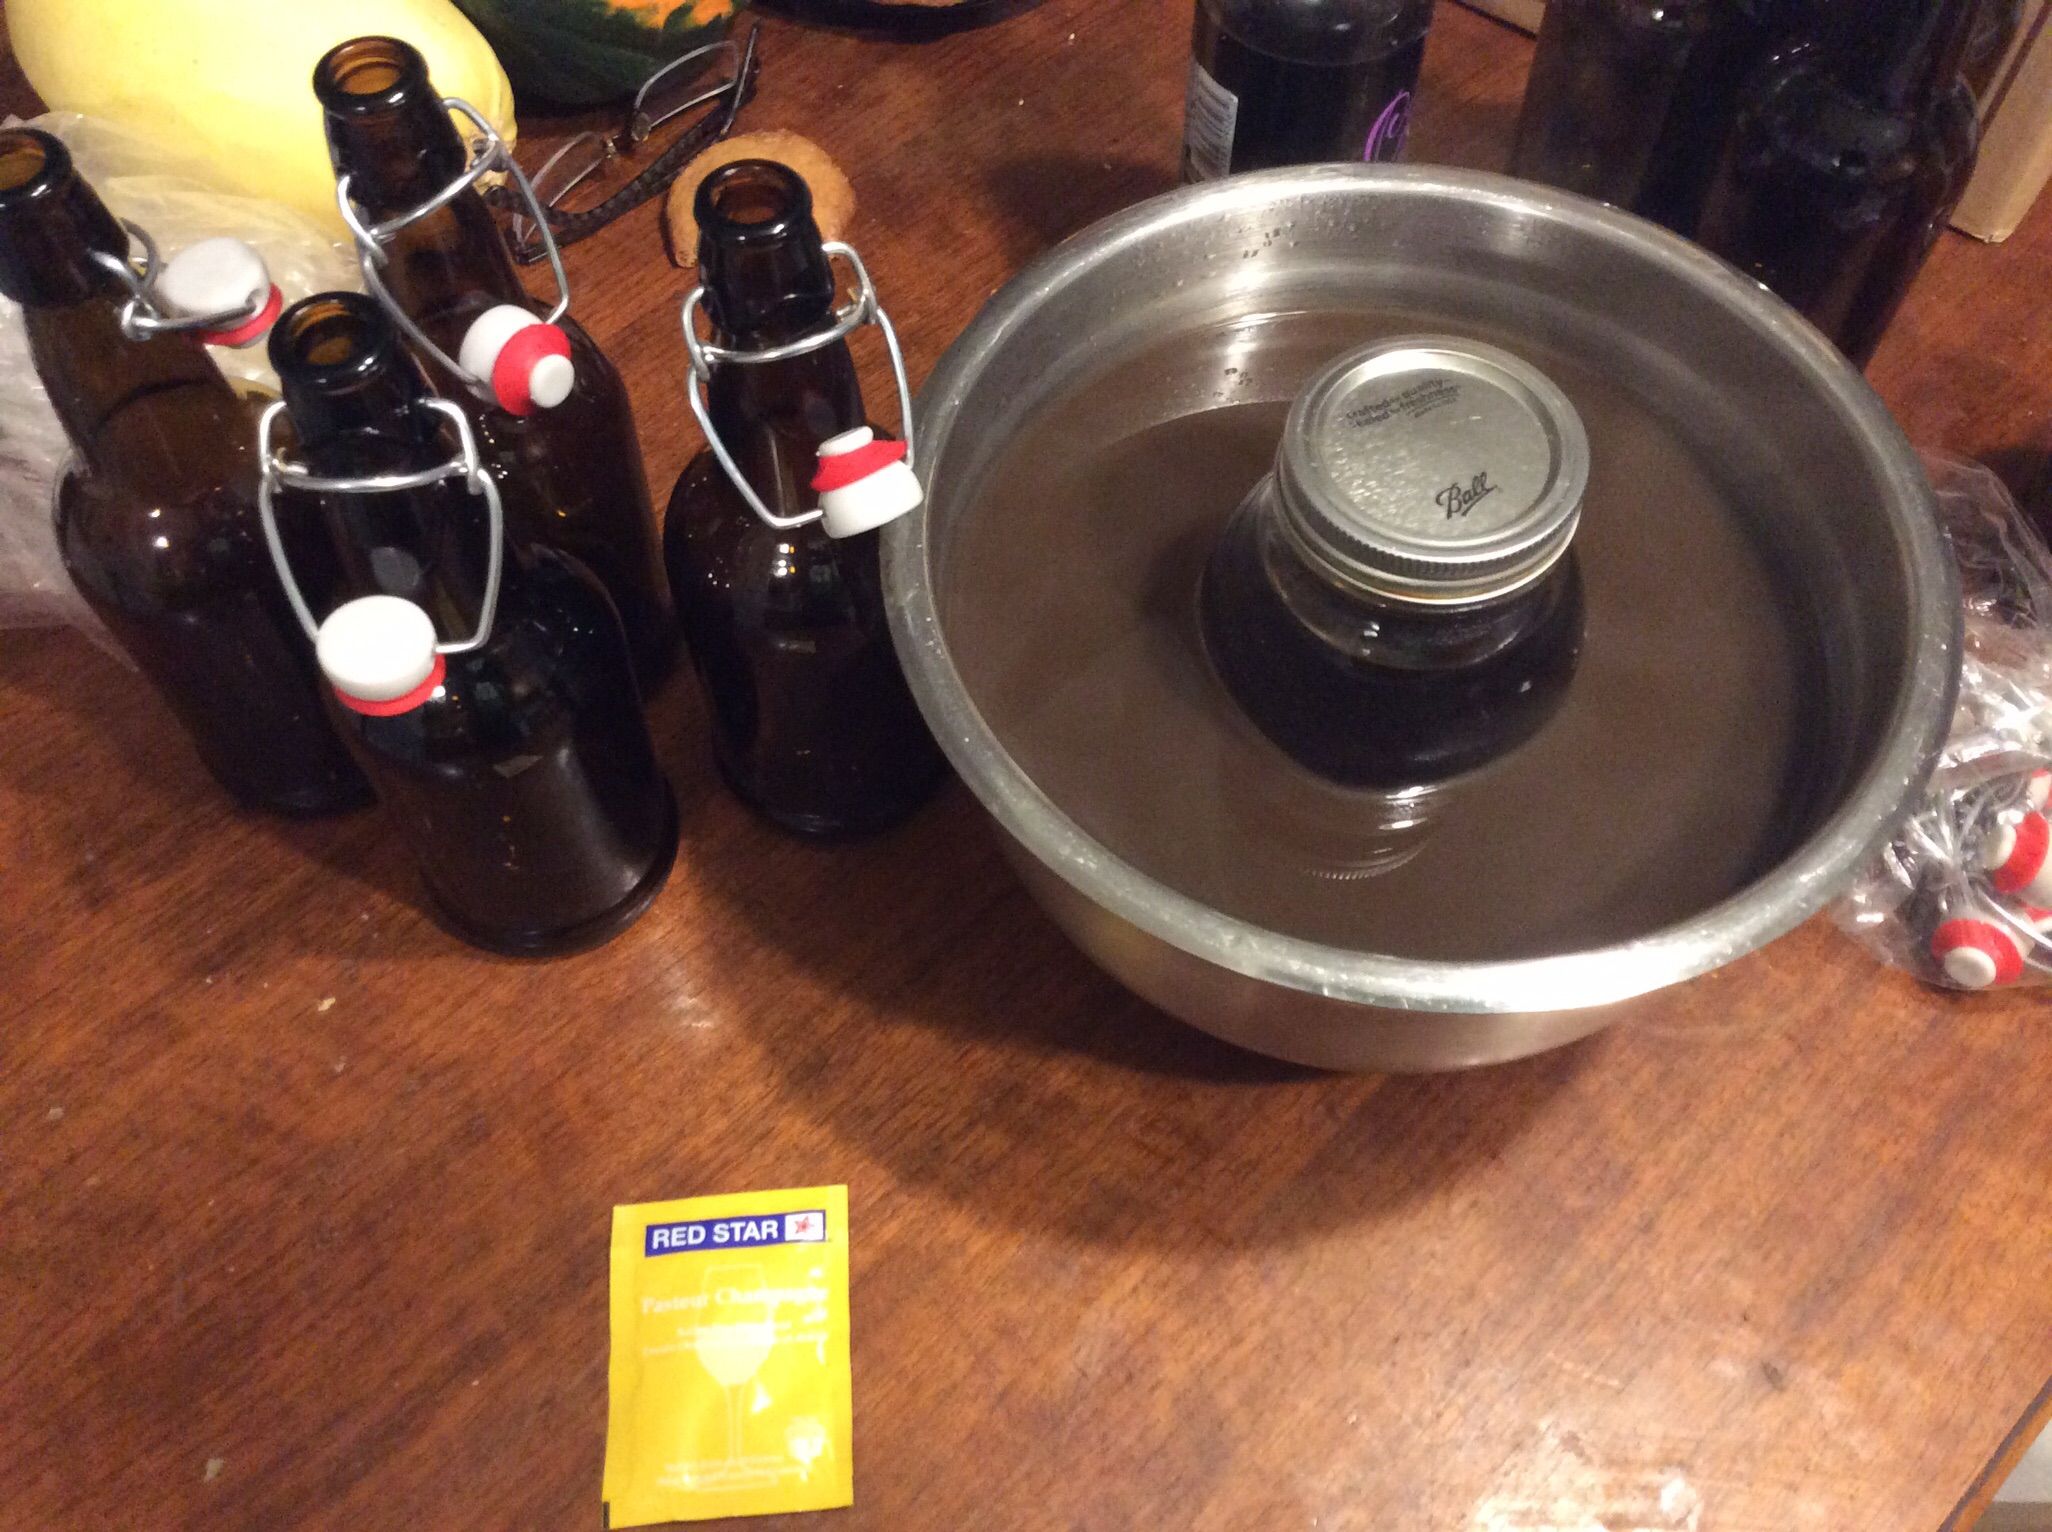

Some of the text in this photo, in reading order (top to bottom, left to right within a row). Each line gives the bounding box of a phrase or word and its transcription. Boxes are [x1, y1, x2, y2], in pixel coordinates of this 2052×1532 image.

[1435, 471, 1498, 520] Ball
[652, 1219, 778, 1249] RED STAR
